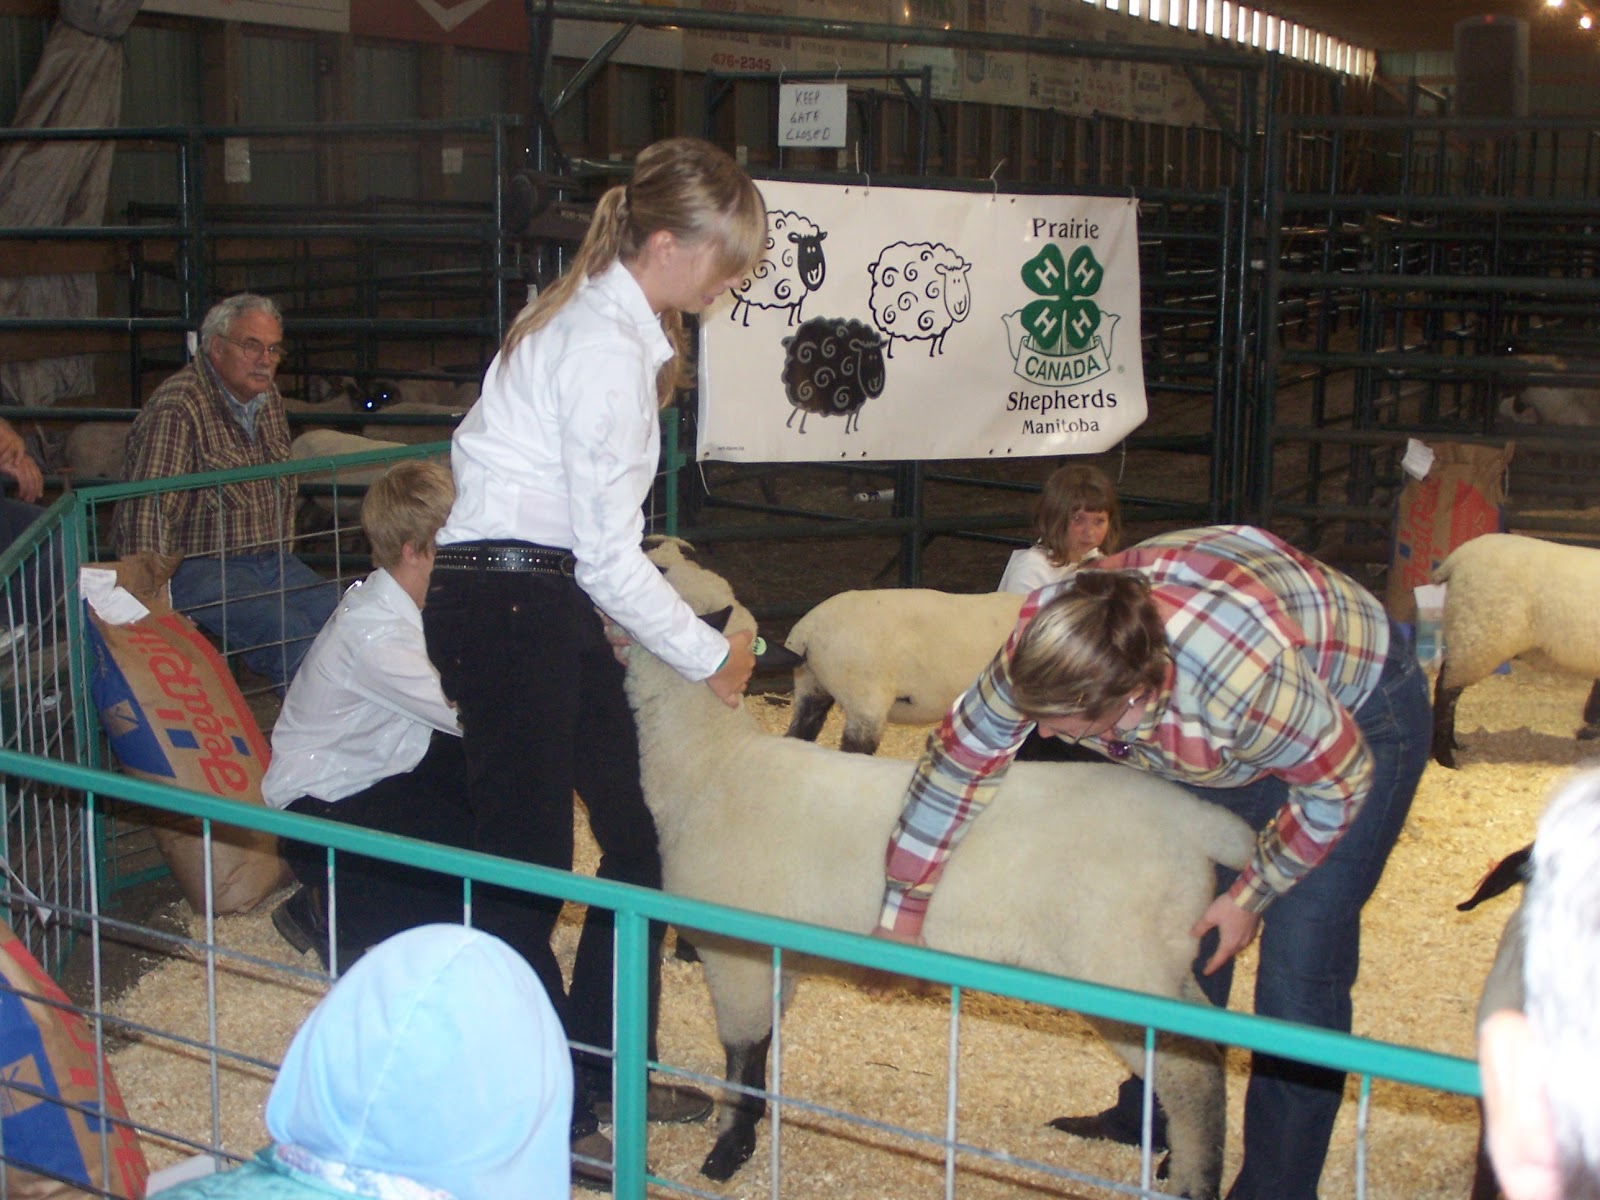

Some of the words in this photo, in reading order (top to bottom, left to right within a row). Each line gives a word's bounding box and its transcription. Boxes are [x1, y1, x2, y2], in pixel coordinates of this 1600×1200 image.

[795, 90, 820, 105] KEEP
[790, 111, 819, 124] GATE
[1032, 217, 1100, 239] Prairie
[1035, 258, 1059, 288] H
[1074, 257, 1096, 287] H
[1034, 307, 1058, 337] H
[1071, 309, 1092, 338] H
[1025, 354, 1101, 382] CANADA
[1006, 389, 1117, 415] Shepherds
[1022, 418, 1100, 434] Manitoba
